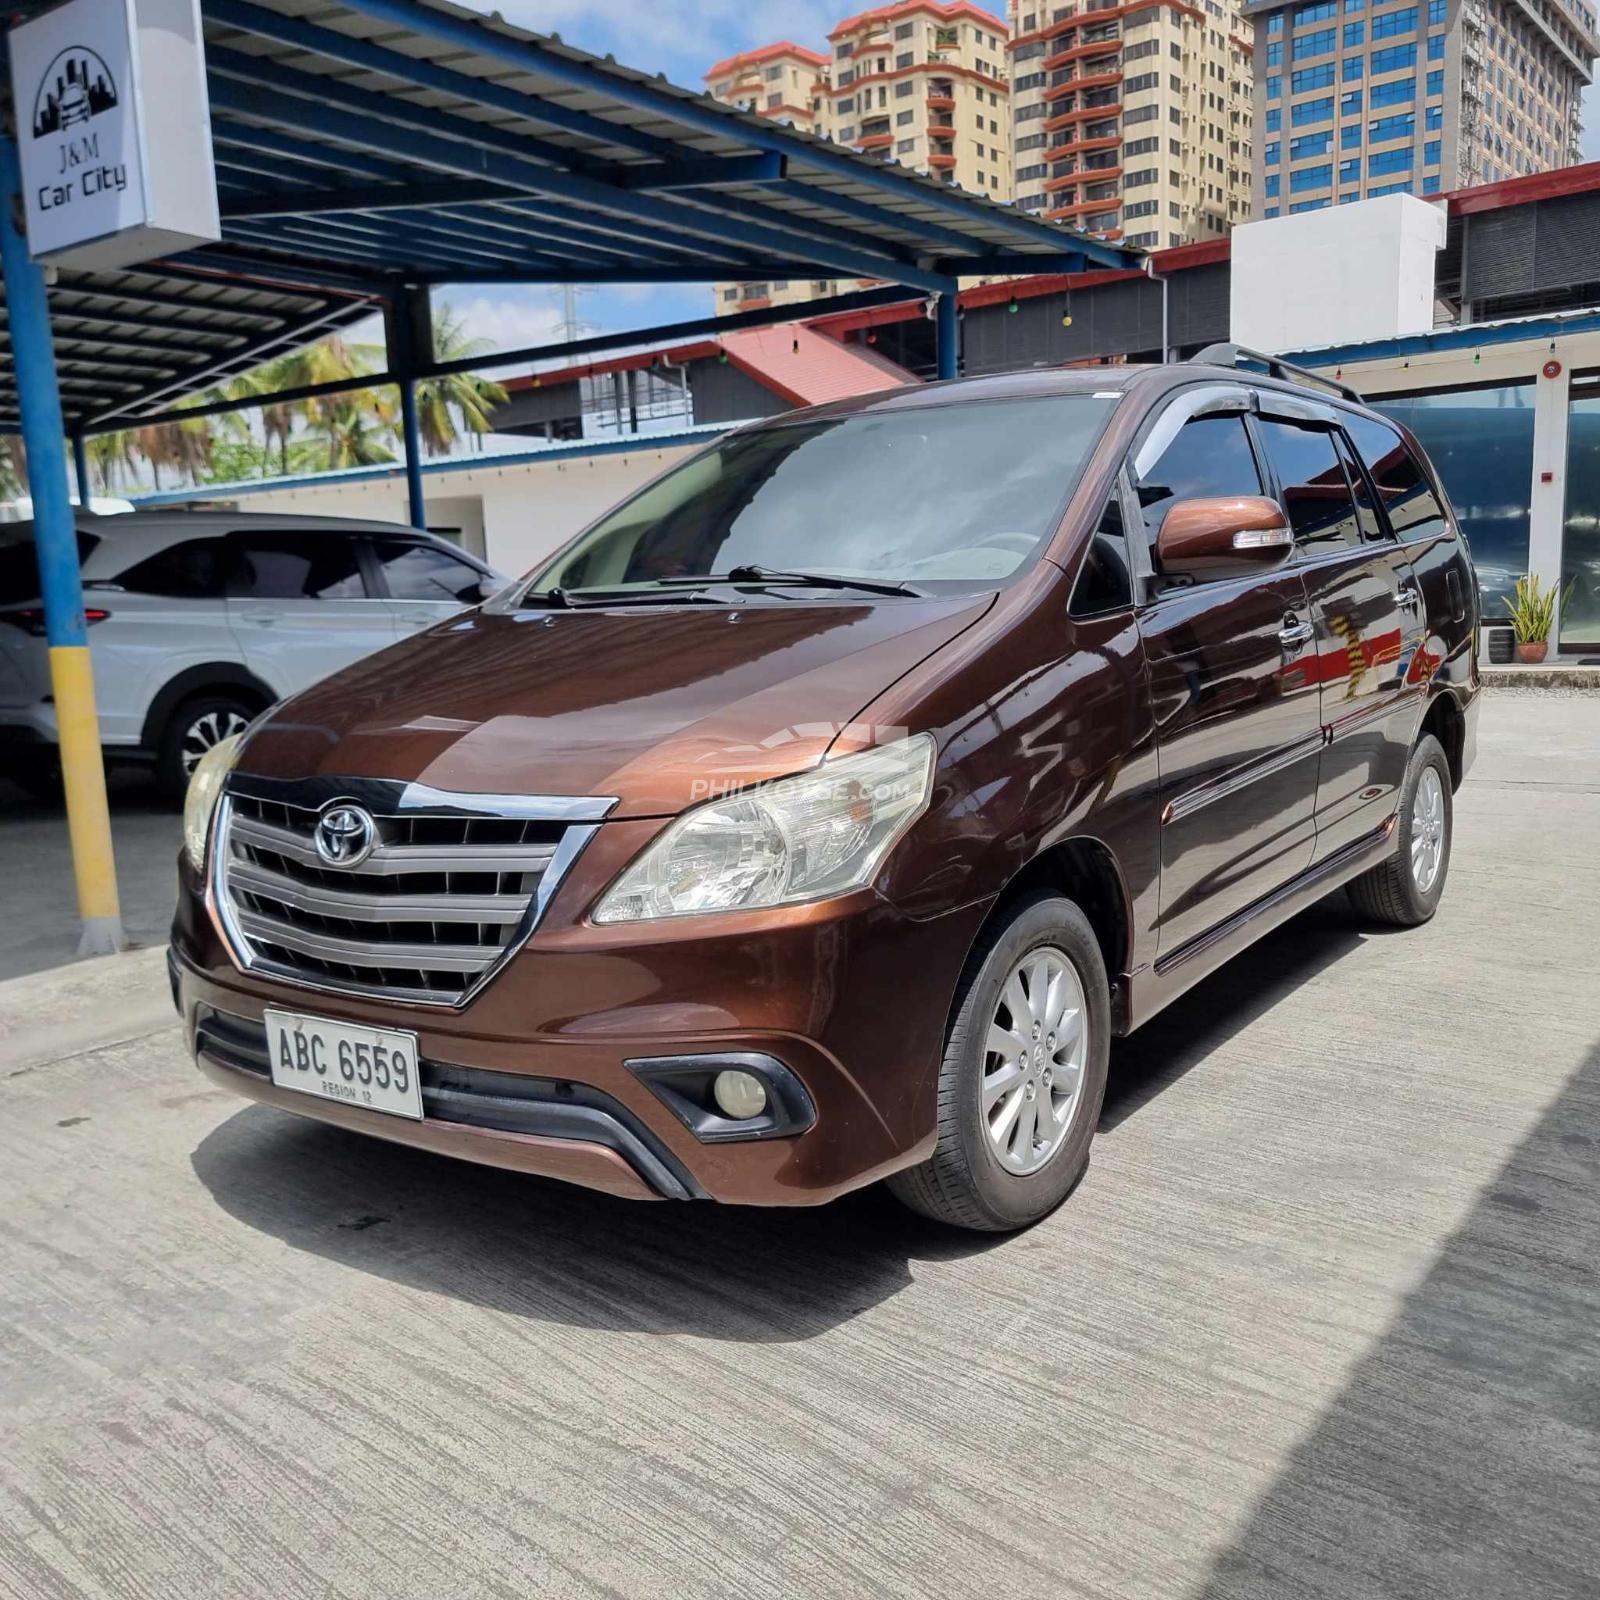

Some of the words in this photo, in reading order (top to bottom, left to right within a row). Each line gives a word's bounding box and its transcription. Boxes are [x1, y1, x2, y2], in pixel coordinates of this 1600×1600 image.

[60, 133, 99, 173] J&M
[39, 184, 73, 211] Car
[82, 165, 126, 195] City
[280, 1029, 327, 1075] ABC
[338, 1040, 409, 1093] 6559
[321, 1081, 356, 1099] REGION
